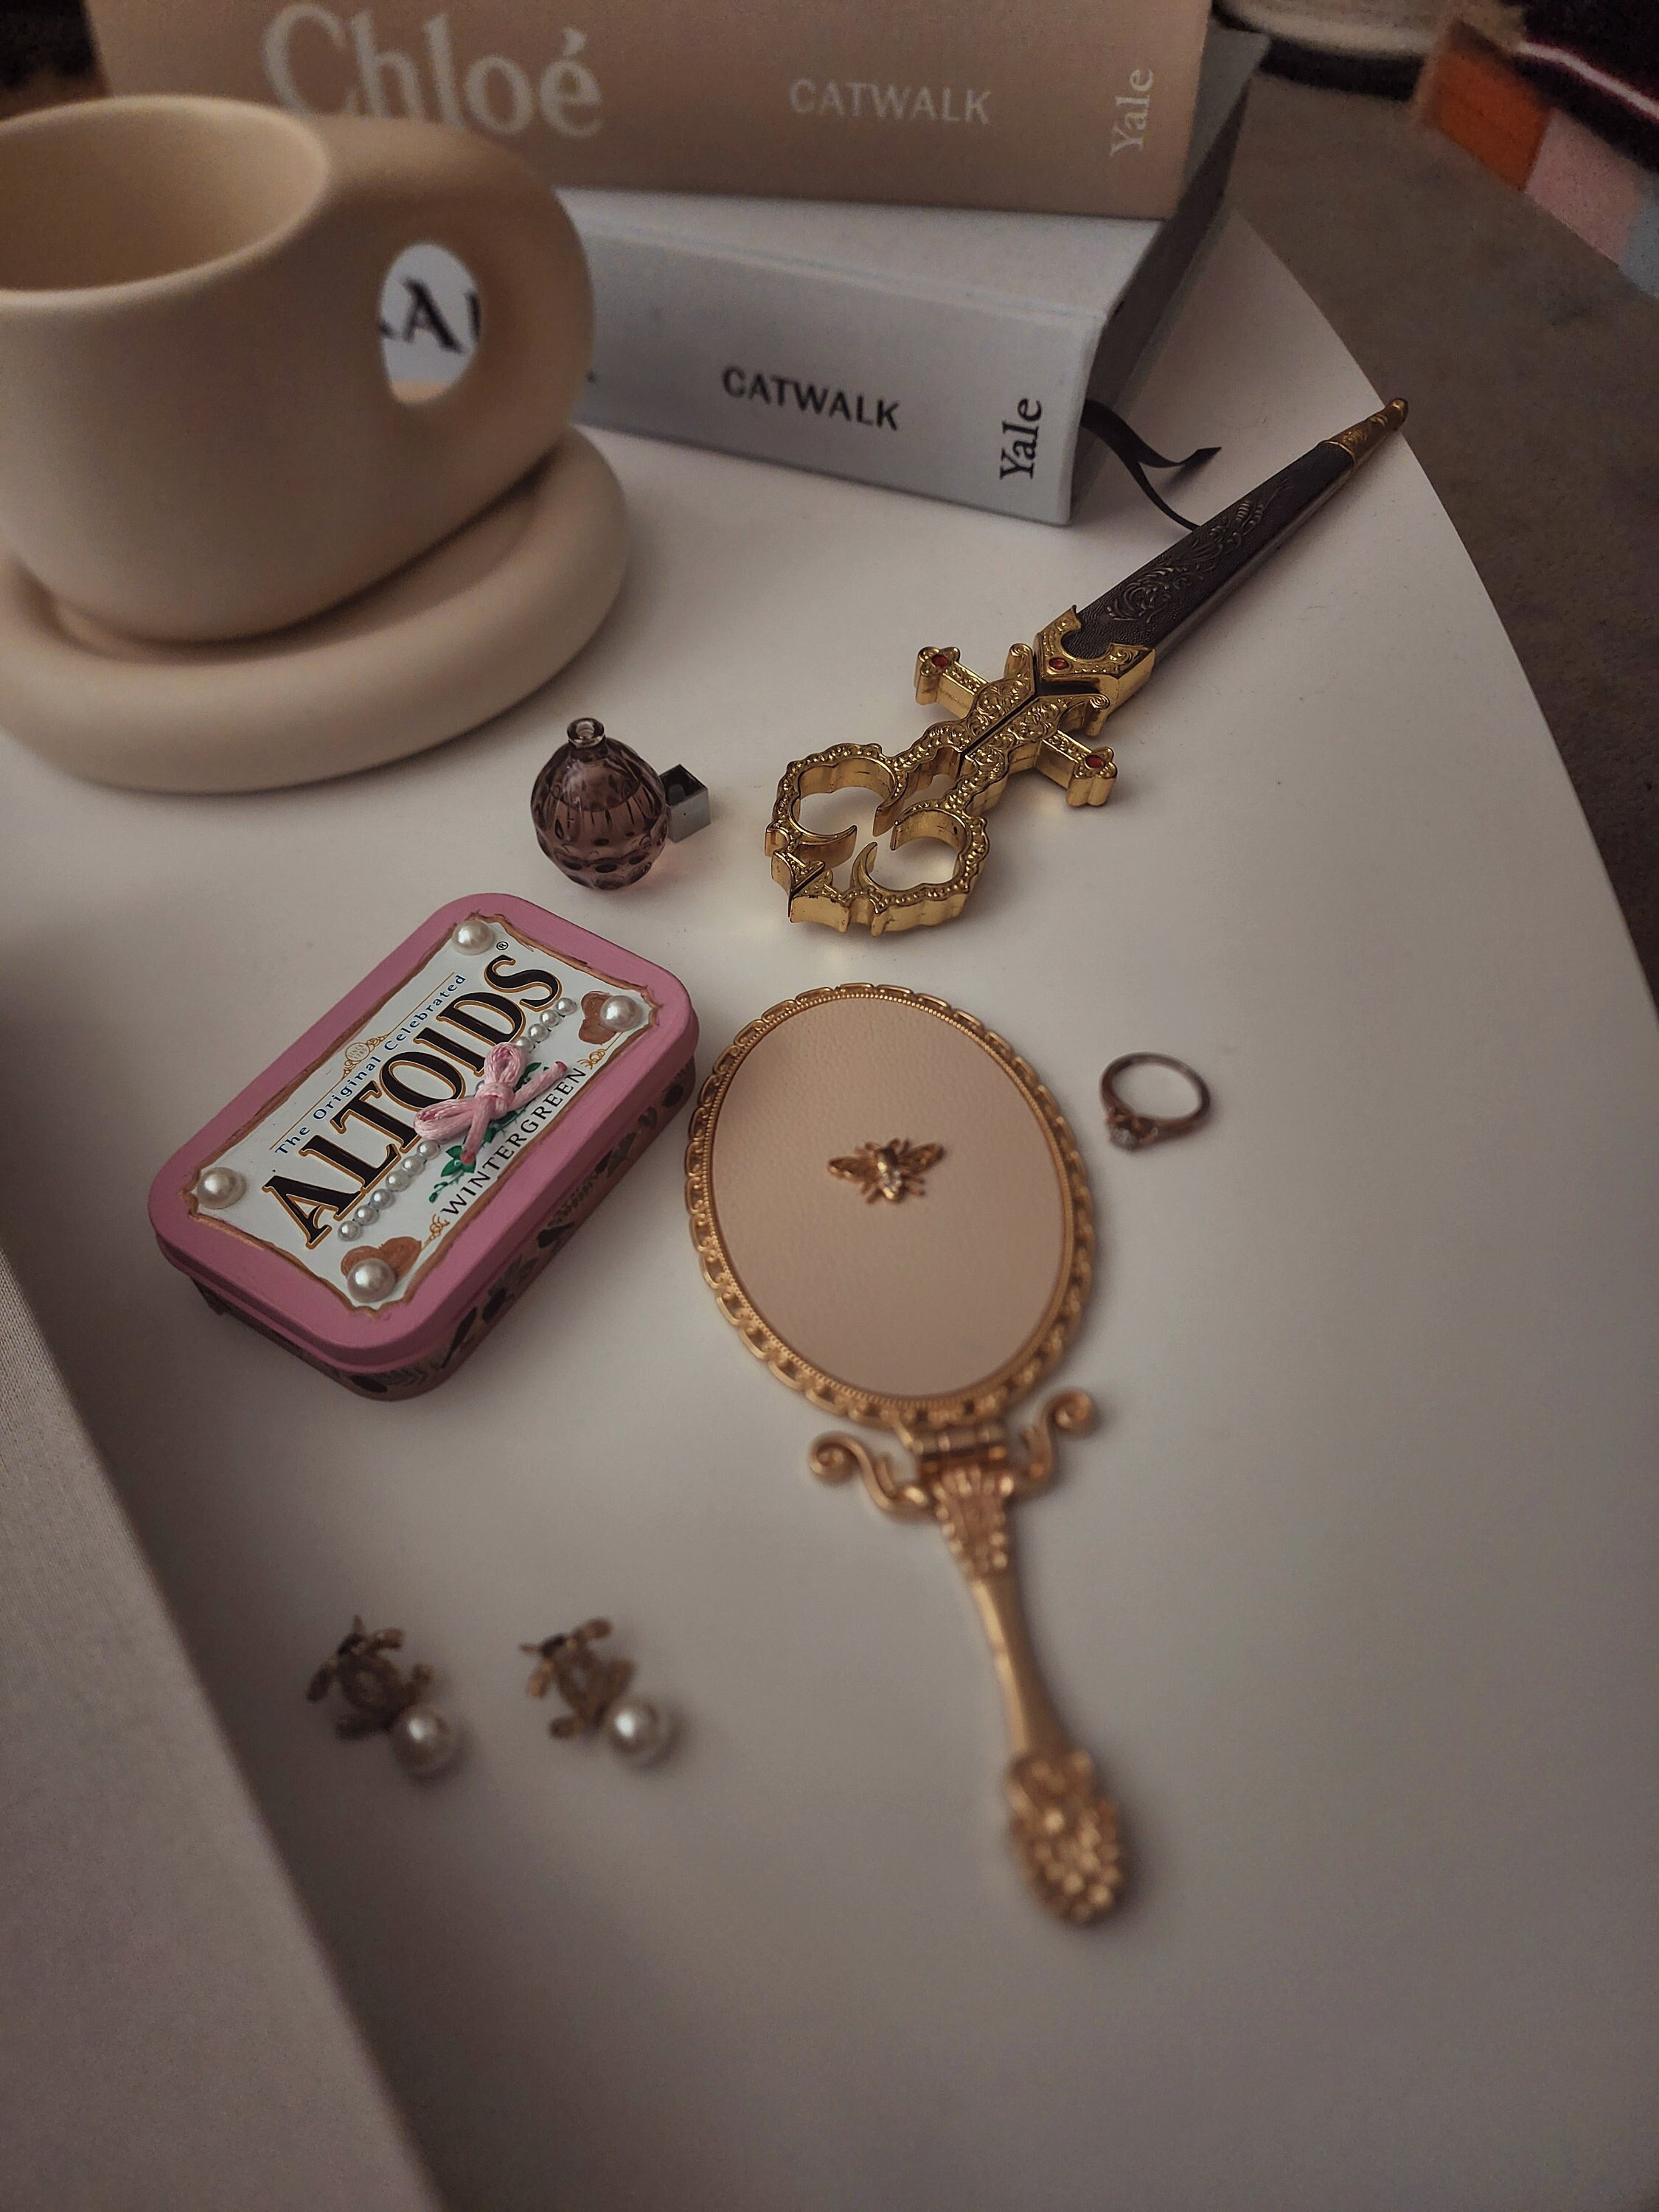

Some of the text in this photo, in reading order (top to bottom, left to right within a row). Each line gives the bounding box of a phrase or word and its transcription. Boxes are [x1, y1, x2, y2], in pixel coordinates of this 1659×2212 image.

[261, 3, 993, 139] Chloé CATWALK
[1109, 68, 1154, 158] Yale
[721, 366, 901, 431] CATWALK
[1000, 397, 1043, 481] Yale
[261, 954, 563, 1251] ALTOIDS
[275, 974, 467, 1155] The Original Celebrated
[440, 1068, 587, 1215] WINTERGREEN
